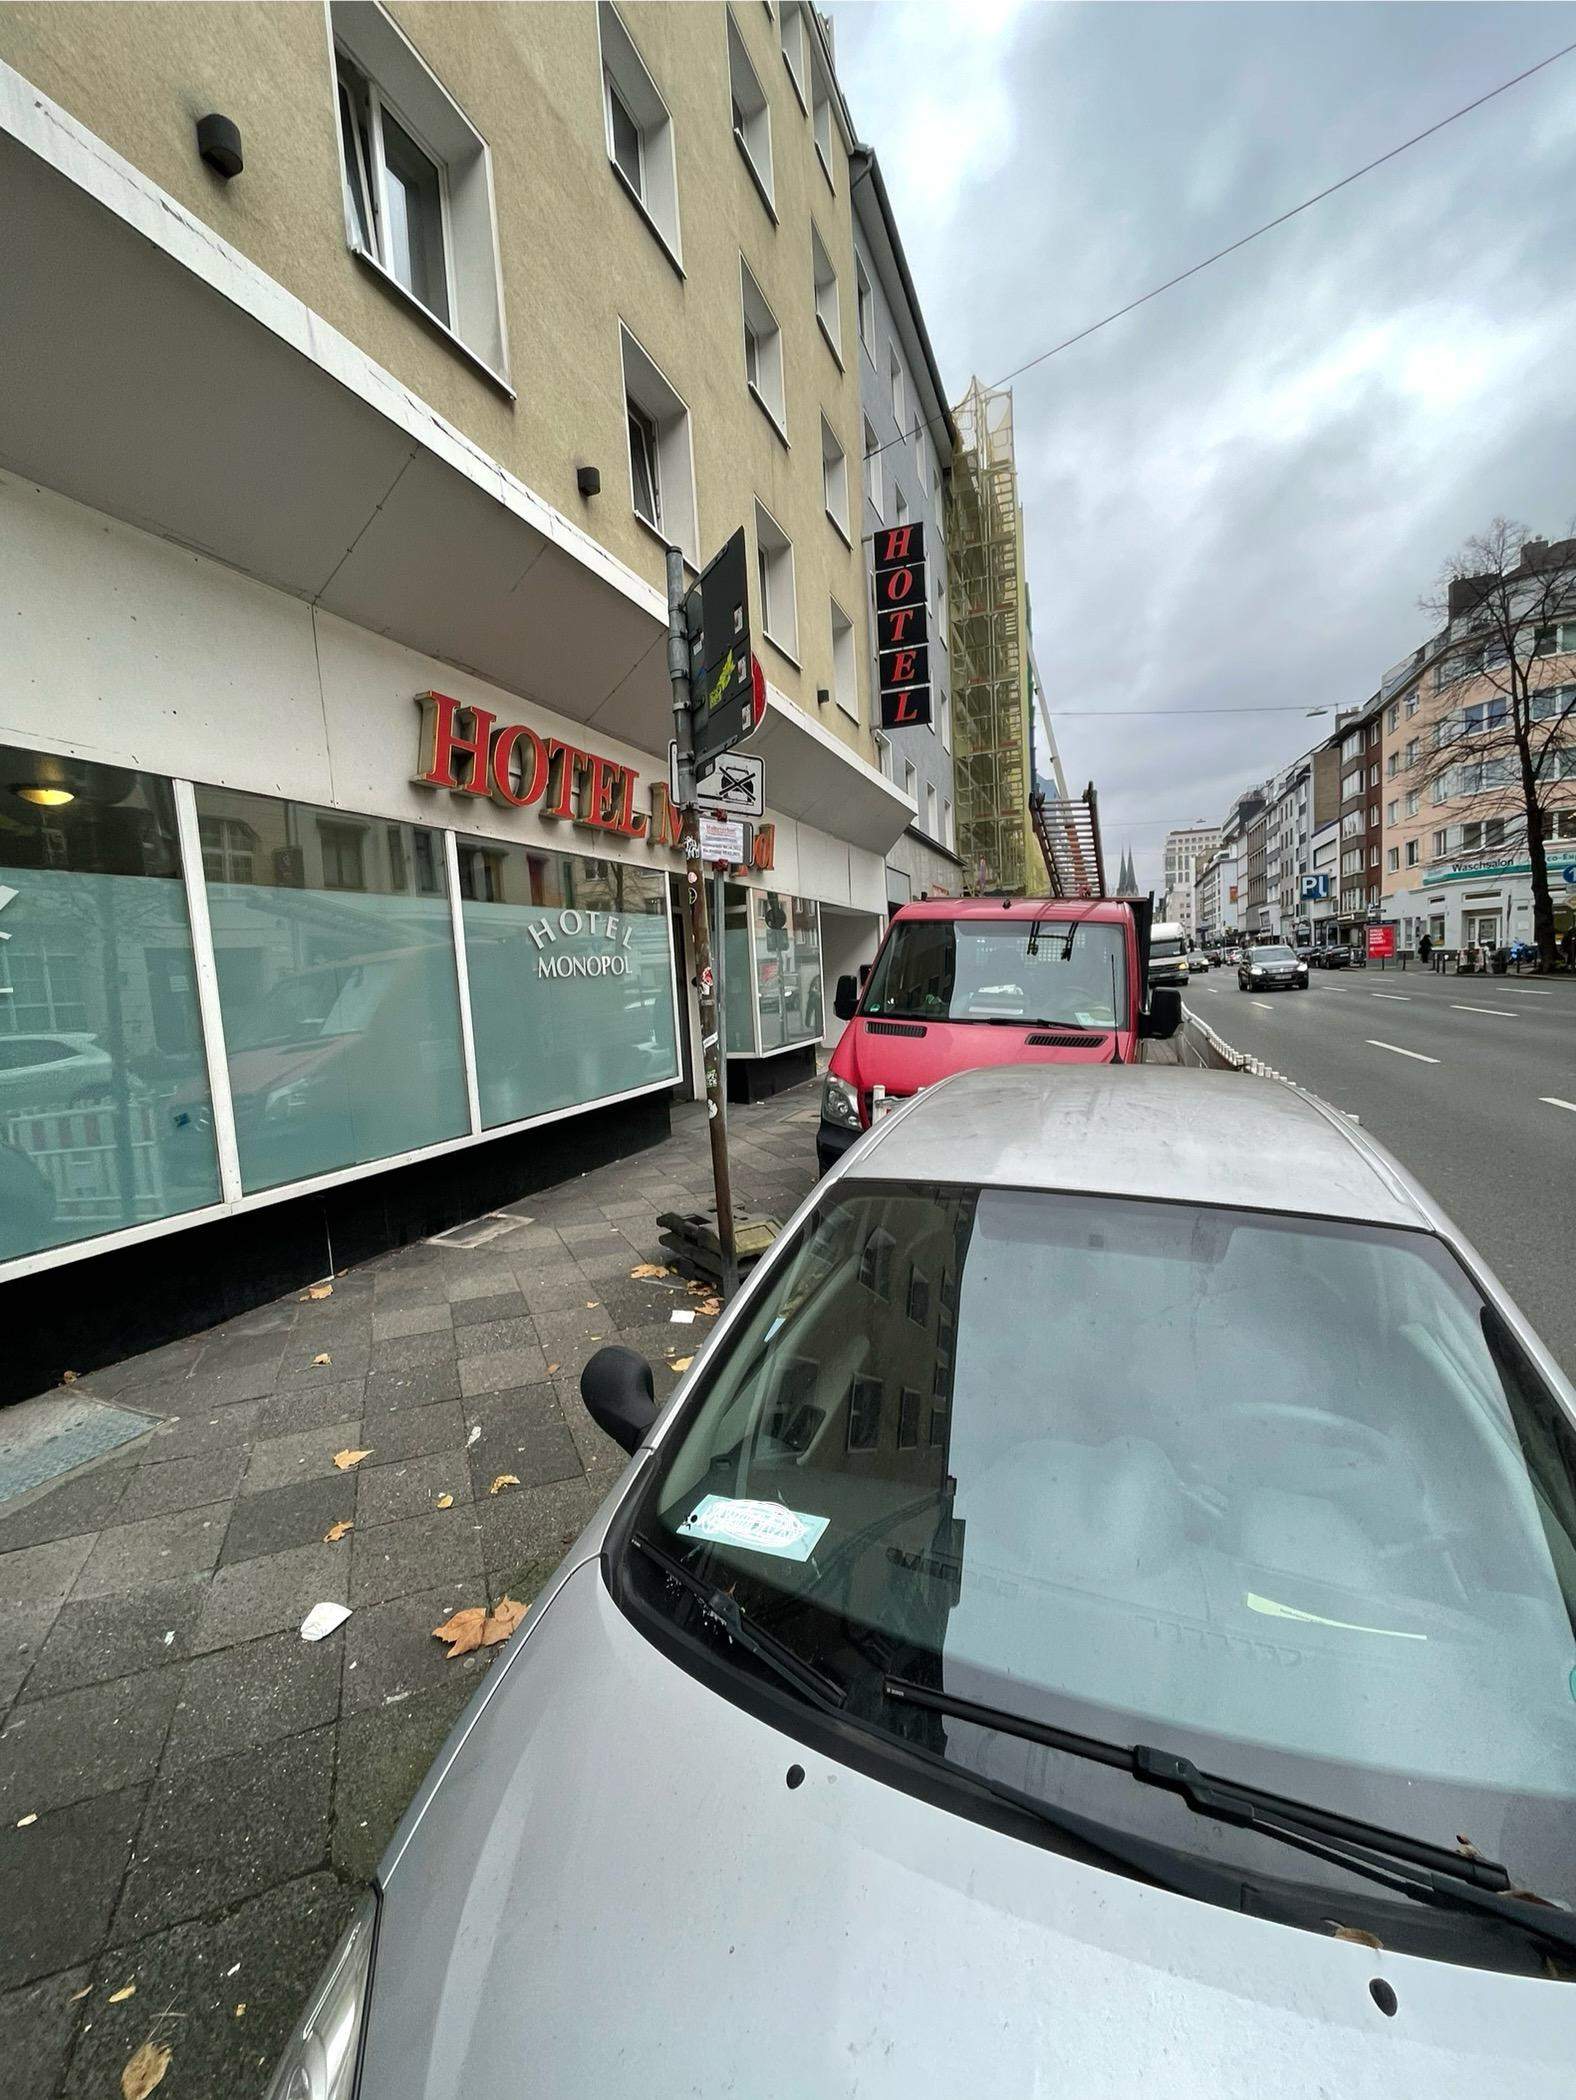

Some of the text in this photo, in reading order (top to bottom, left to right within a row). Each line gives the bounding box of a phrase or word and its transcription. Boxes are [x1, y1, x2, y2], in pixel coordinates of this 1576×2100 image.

[883, 526, 919, 722] HOTEL
[411, 690, 648, 838] HOTEL
[1452, 859, 1514, 872] Waschsalon
[527, 908, 633, 951] HOTEL
[538, 955, 633, 978] MONOPOL
